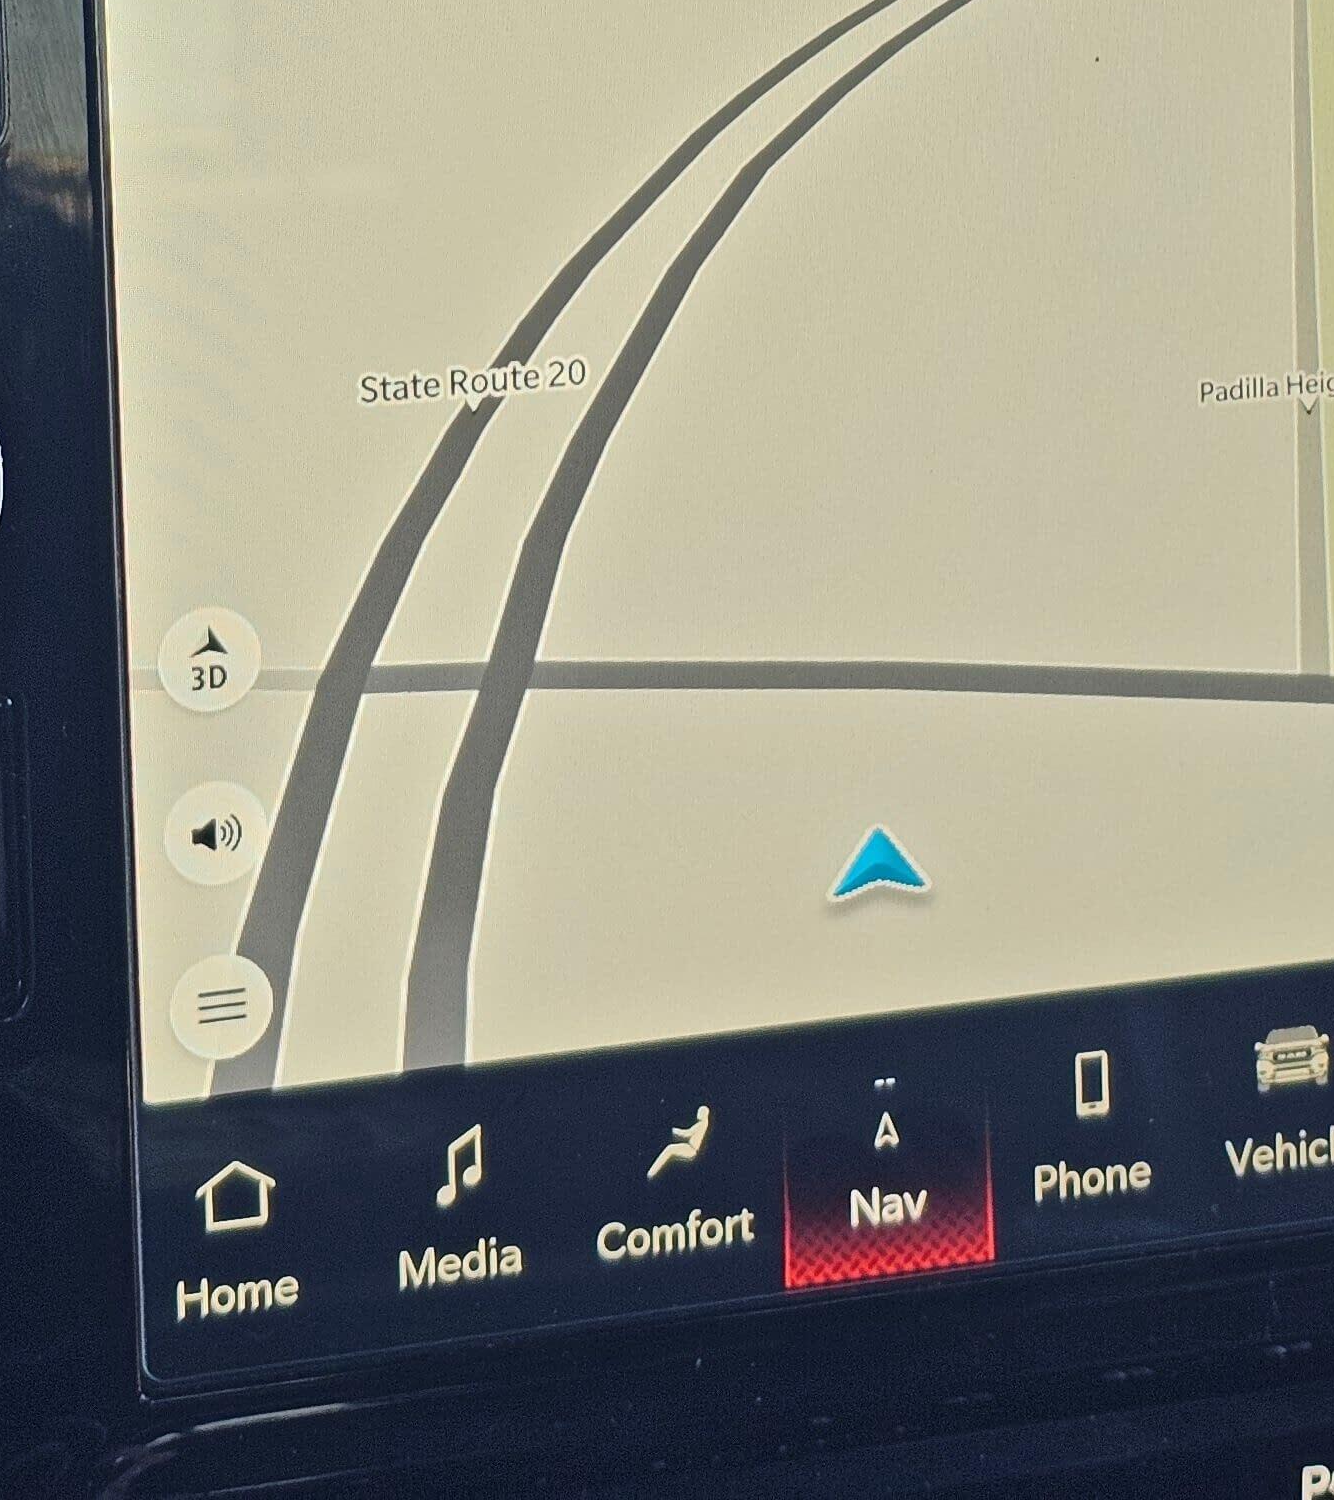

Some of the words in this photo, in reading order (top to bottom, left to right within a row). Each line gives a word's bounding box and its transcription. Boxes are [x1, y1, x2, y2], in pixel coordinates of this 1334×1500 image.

[361, 374, 440, 404] State
[450, 365, 540, 396] Route
[548, 358, 586, 388] 20
[1200, 376, 1279, 403] Padilla
[191, 666, 228, 691] 3D
[1034, 1160, 1152, 1204] Phone
[850, 1186, 928, 1228] Nav
[596, 1207, 755, 1261] Comfort
[398, 1238, 523, 1291] Media
[176, 1275, 300, 1322] Home
